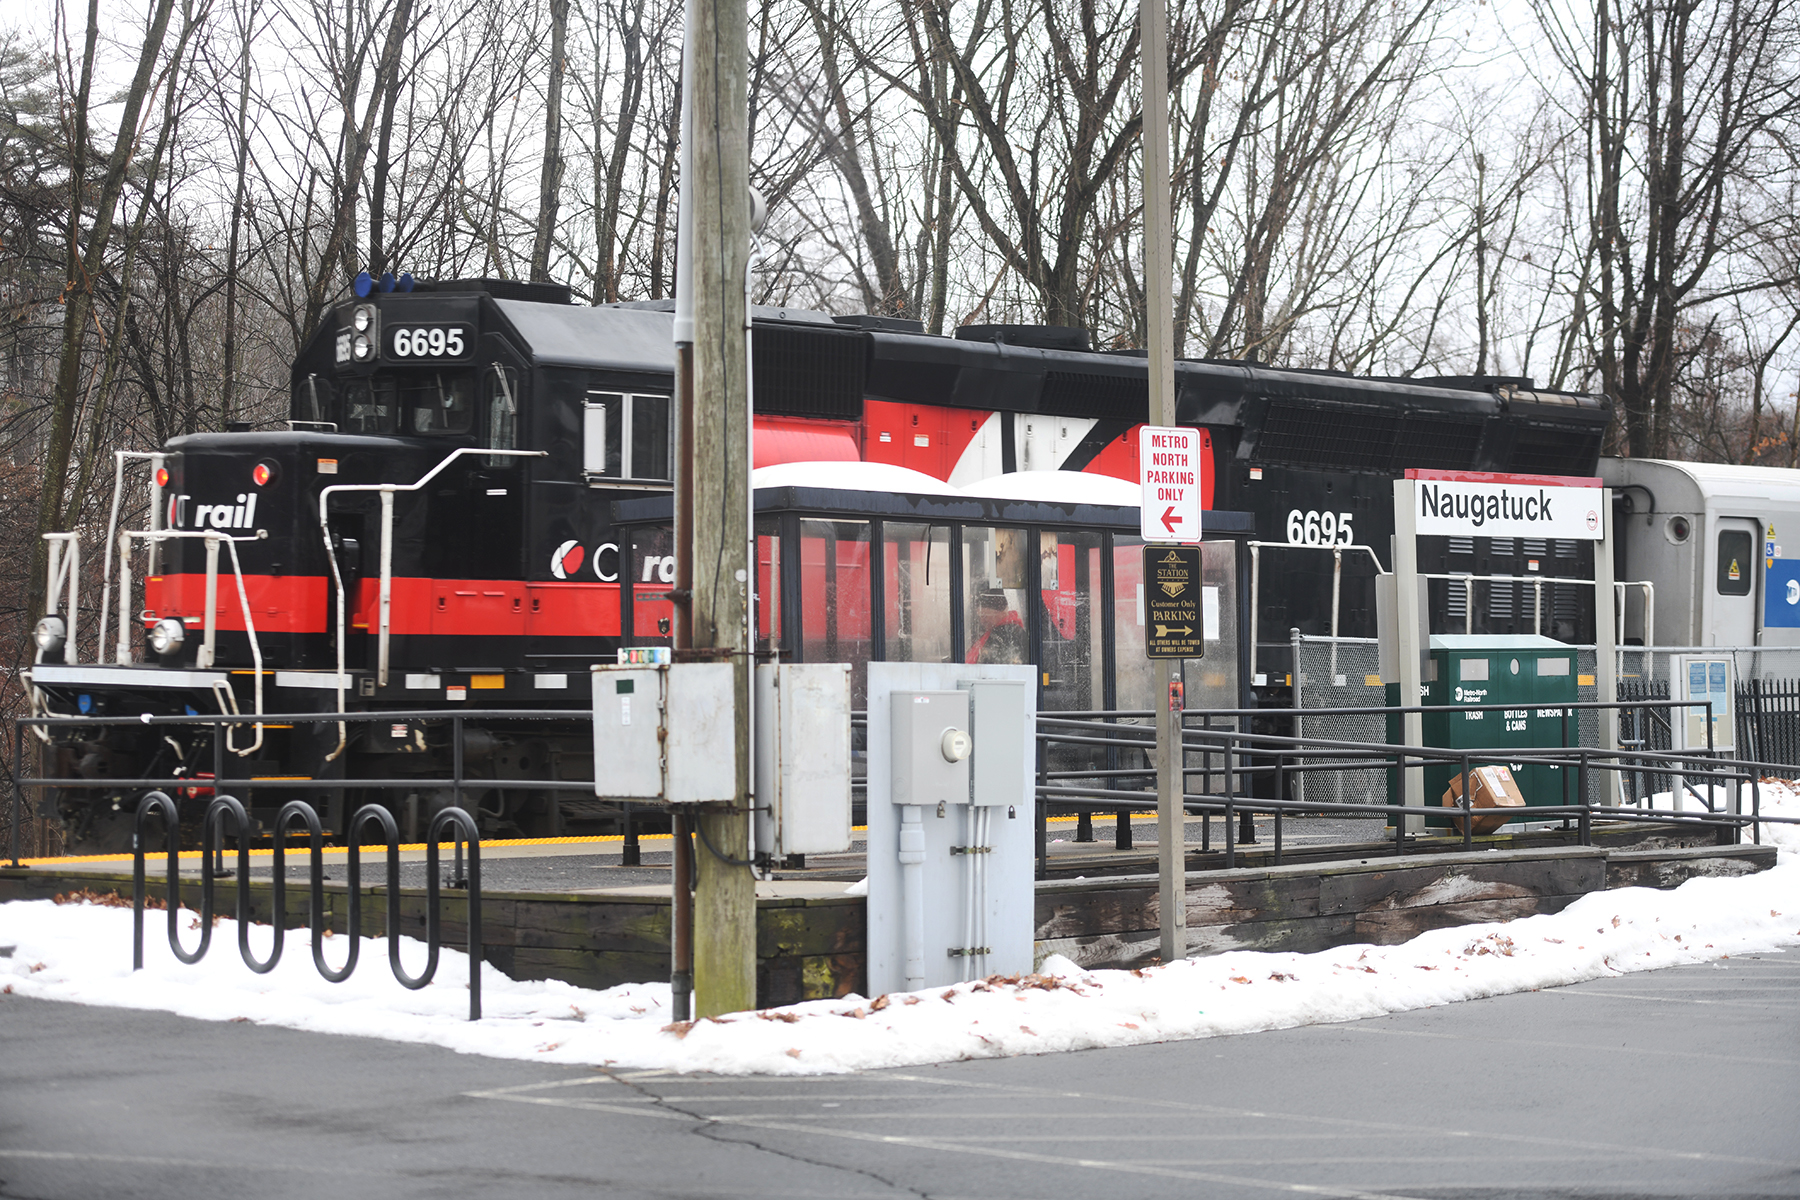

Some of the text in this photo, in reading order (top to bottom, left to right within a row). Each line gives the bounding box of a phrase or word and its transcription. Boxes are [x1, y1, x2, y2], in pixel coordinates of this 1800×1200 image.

[394, 328, 464, 356] 6695
[1152, 435, 1188, 449] METRO
[1153, 453, 1188, 467] NORTH
[1147, 470, 1194, 485] PARKING
[1158, 487, 1184, 501] ONLY
[194, 492, 257, 528] rail
[1421, 484, 1553, 527] Naugatuck
[1286, 509, 1353, 546] 6695
[642, 554, 674, 583] ra
[1157, 569, 1189, 577] STATION
[1181, 600, 1196, 609] Only
[1153, 611, 1196, 621] PARKING
[1465, 710, 1484, 720] TRASH
[1503, 709, 1528, 719] BOTTLES
[1536, 708, 1573, 718] NEWSPAR
[1505, 720, 1527, 731] & CANS
